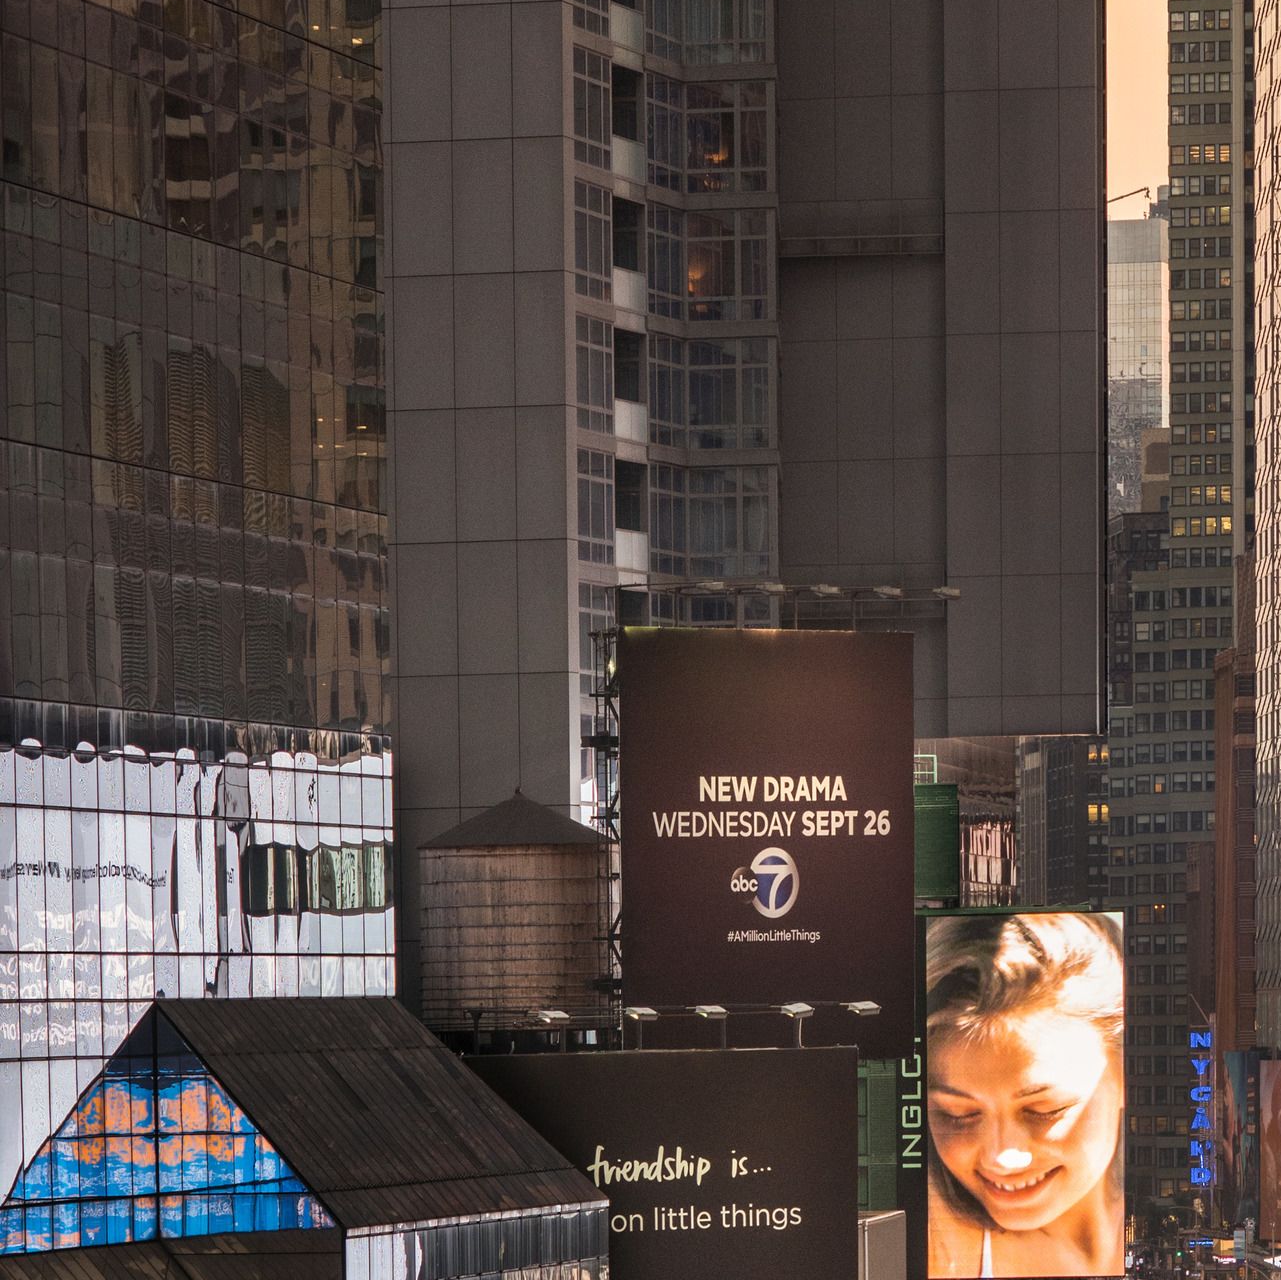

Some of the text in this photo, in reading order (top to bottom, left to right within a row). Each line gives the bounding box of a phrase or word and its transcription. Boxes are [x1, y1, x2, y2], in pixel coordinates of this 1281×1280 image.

[699, 775, 847, 802] NEW DRAMA
[652, 809, 891, 838] WEDNESDAY SEPT 26
[730, 876, 759, 893] abc
[727, 929, 821, 944] #AMillionLittleThings
[586, 1144, 773, 1188] friendship is...
[610, 1203, 802, 1233] on little things
